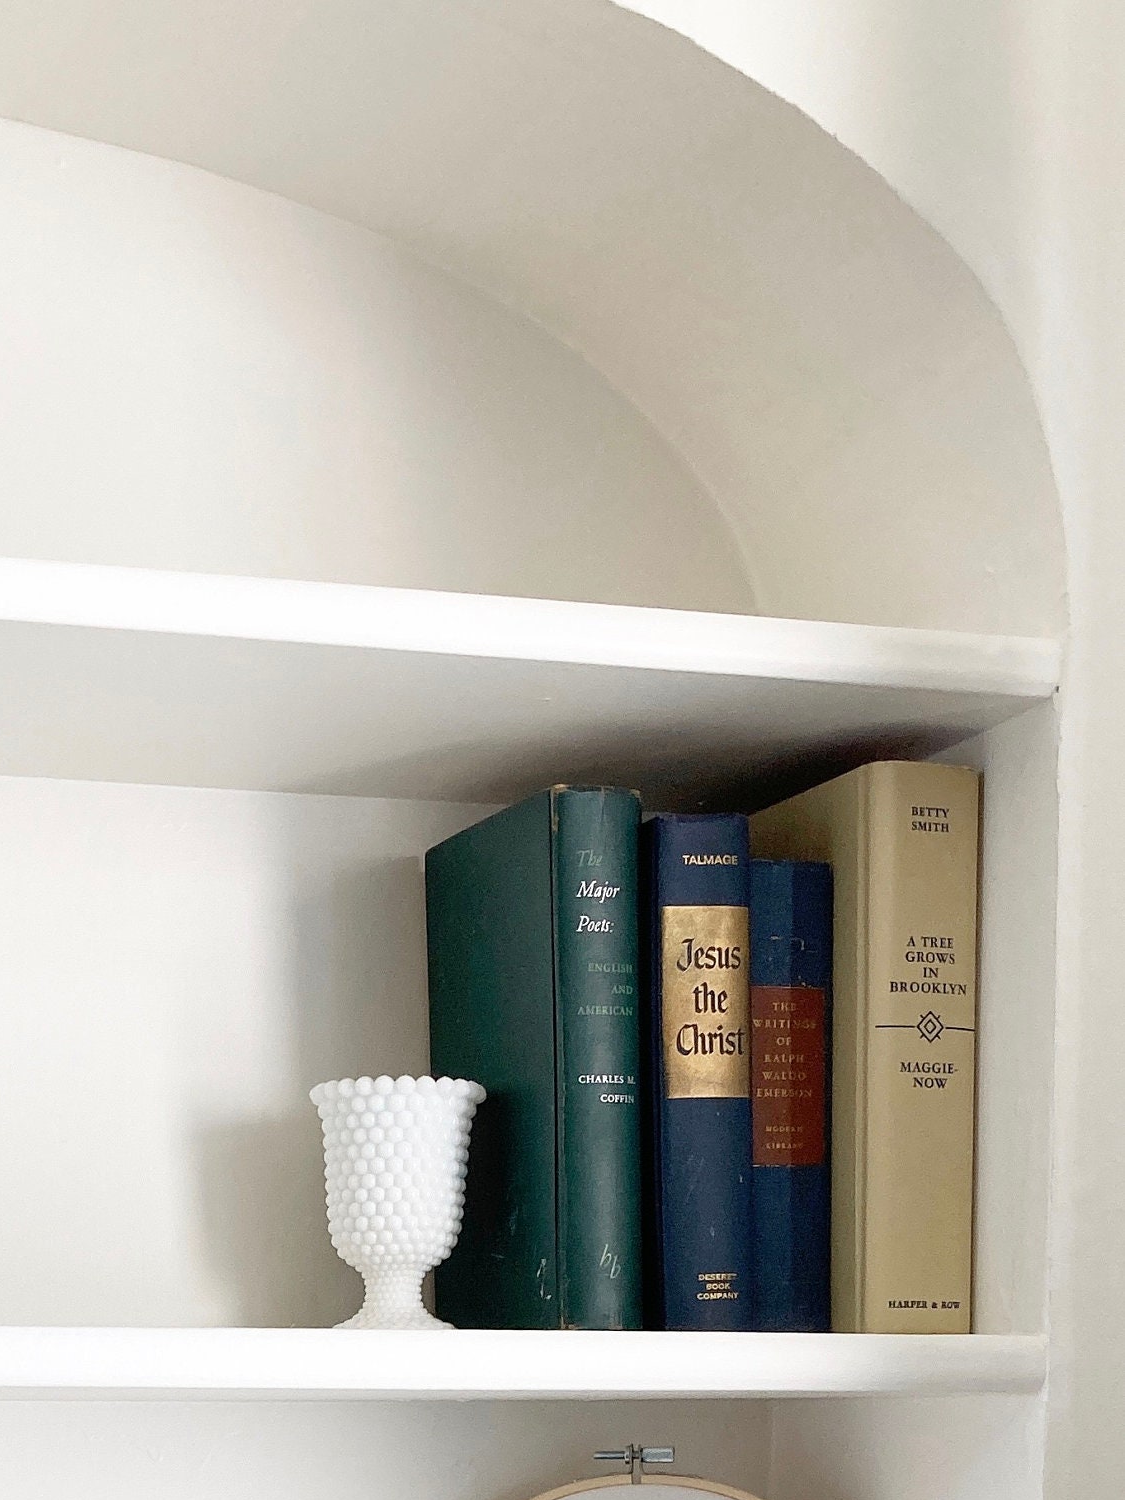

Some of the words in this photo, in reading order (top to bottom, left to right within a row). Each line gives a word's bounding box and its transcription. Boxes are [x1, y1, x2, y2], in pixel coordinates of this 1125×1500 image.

[911, 806, 950, 819] BETTY
[911, 820, 950, 833] SMITH
[577, 850, 603, 867] The
[682, 854, 738, 866] TALMAGE
[576, 880, 620, 903] Major
[906, 935, 916, 947] A
[921, 936, 954, 949] TREE
[676, 937, 741, 973] Jesus
[905, 951, 956, 965] GROWS
[923, 966, 940, 979] IN
[611, 984, 633, 995] AND
[889, 980, 968, 996] BROOKLYN
[692, 982, 729, 1014] the
[577, 1005, 633, 1016] AMERICAN
[676, 1023, 746, 1057] Christ
[776, 1036, 792, 1046] OF
[764, 1054, 805, 1064] RALPH
[900, 1061, 958, 1075] MAGGIE-
[578, 1074, 625, 1084] CHARLES
[762, 1071, 807, 1081] WALDO
[913, 1076, 948, 1089] NOW
[600, 1093, 635, 1104] COFFIN
[756, 1088, 813, 1098] EMERSON
[705, 1282, 731, 1290] BOOK
[696, 1291, 739, 1300] COMPANY
[888, 1300, 928, 1309] HARPER
[941, 1301, 961, 1309] ROW
